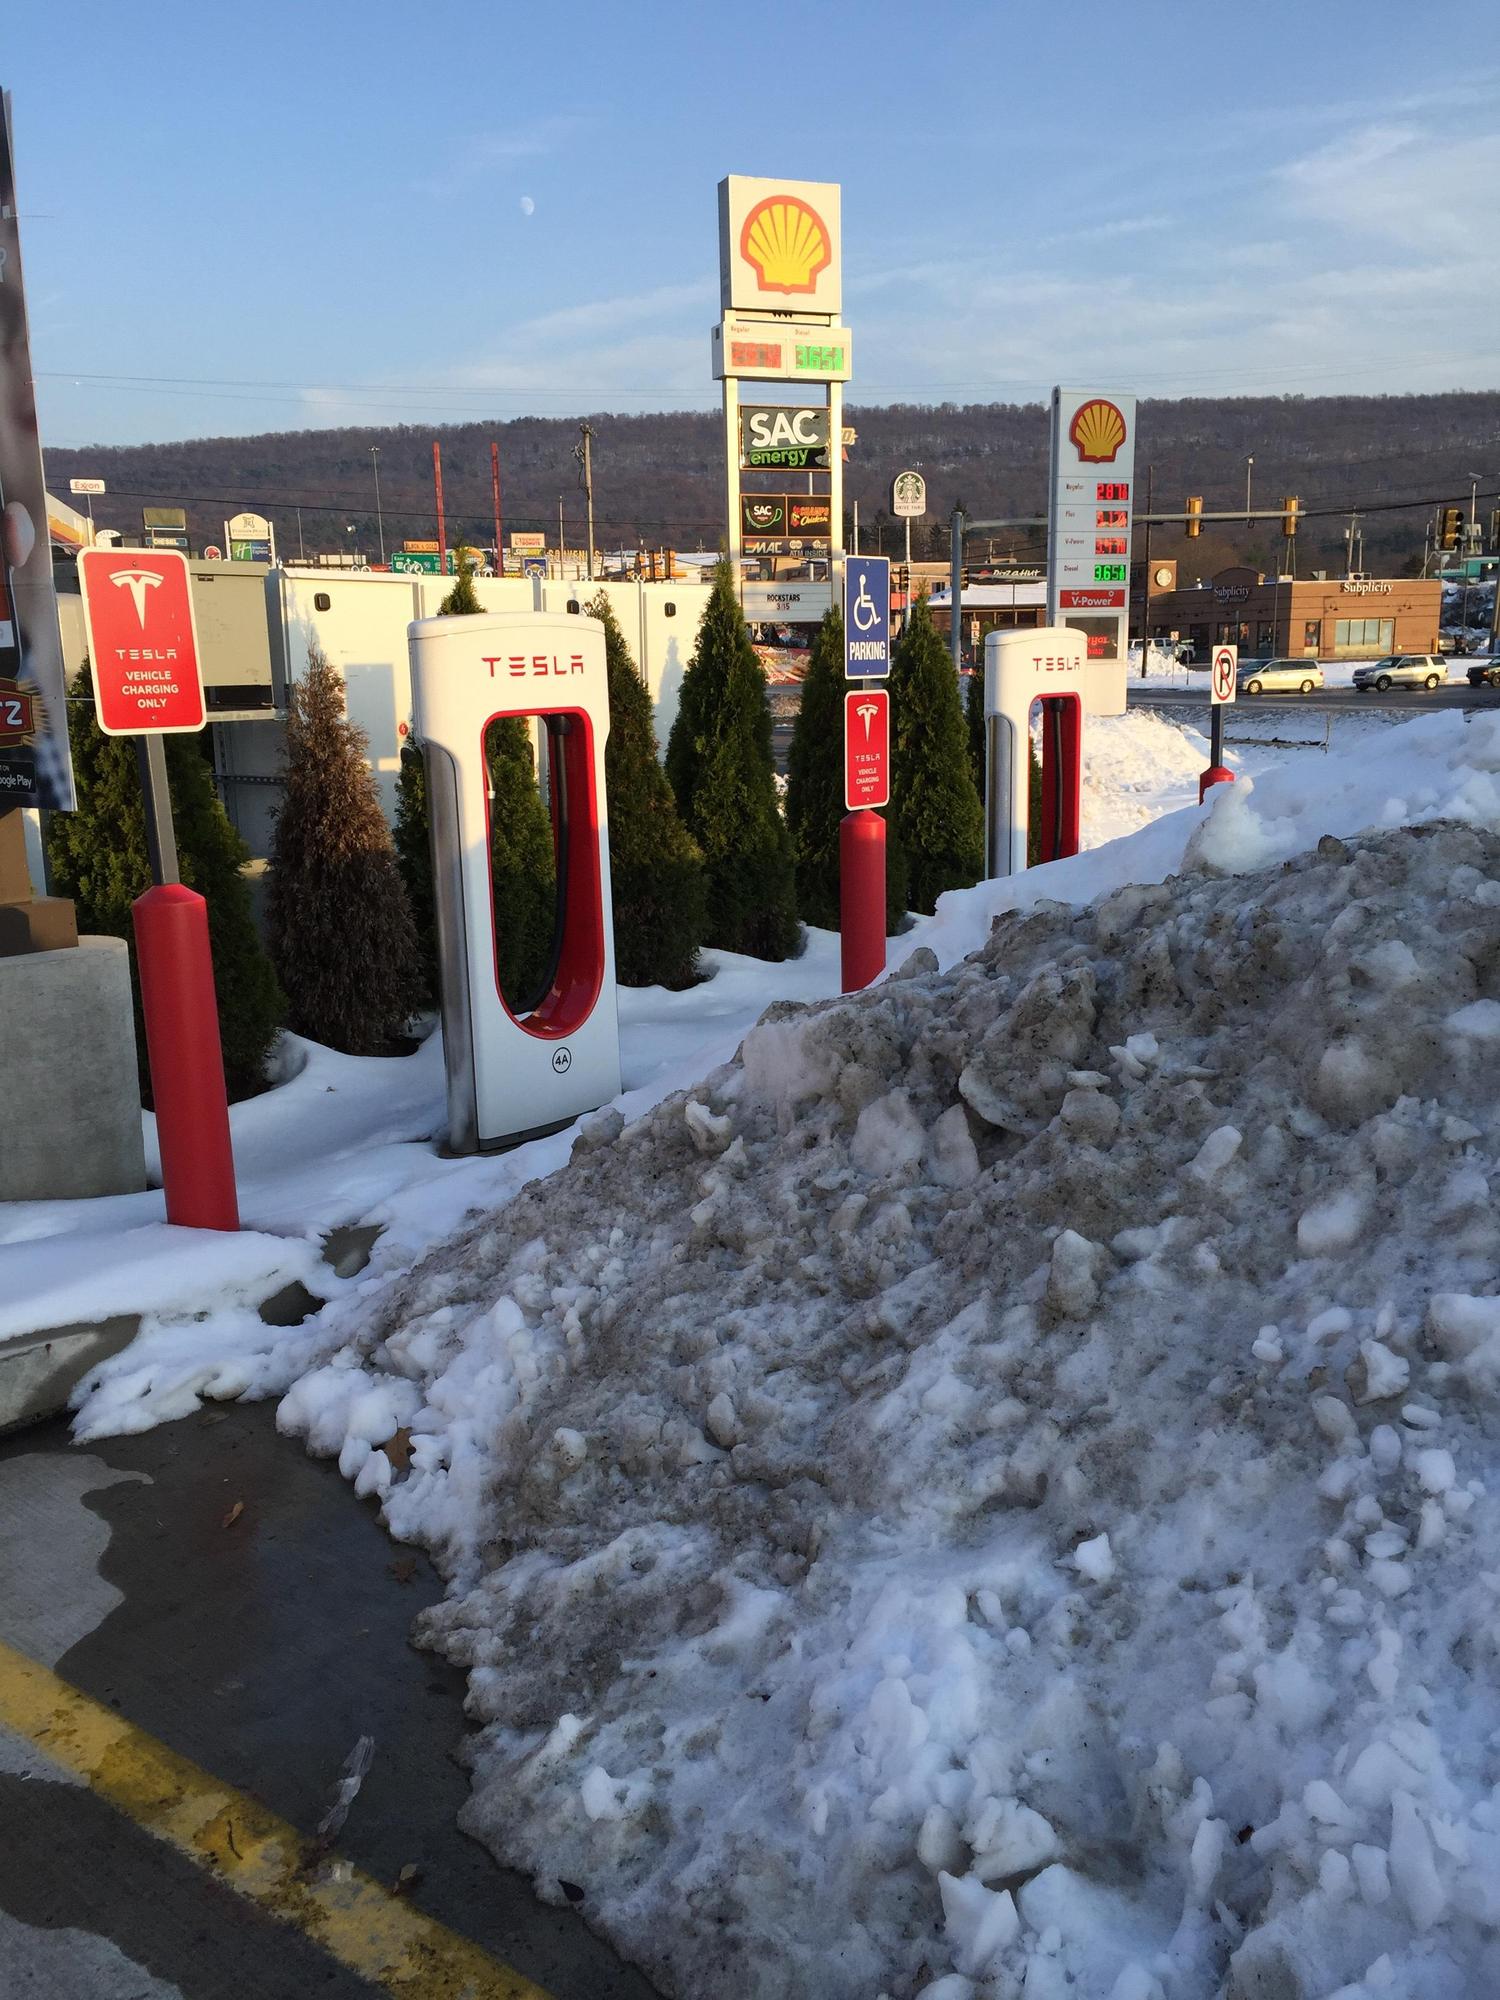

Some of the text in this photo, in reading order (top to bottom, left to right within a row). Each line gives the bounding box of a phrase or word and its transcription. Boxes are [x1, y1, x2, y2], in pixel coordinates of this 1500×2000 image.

[750, 410, 819, 447] SAC
[750, 449, 808, 467] energy
[74, 481, 100, 490] Exxon
[753, 505, 772, 515] SAC
[749, 542, 783, 553] MAC
[1214, 585, 1249, 599] Subplicity
[1344, 582, 1394, 596] Subplicity
[767, 593, 800, 602] ROCKSTARS
[1071, 596, 1112, 606] V-Power
[115, 648, 176, 660] TESLA
[849, 641, 885, 660] PARKING
[481, 655, 583, 677] TESLA
[1032, 656, 1080, 671] TESLA
[126, 671, 172, 681] VEHICLE
[122, 684, 179, 695] CHARGING
[137, 698, 167, 708] ONLY
[855, 754, 880, 762] TESLA
[858, 767, 877, 775] VEHICLE
[17, 774, 31, 789] Play
[856, 776, 880, 785] CHARGING
[555, 1054, 568, 1065] 4A
